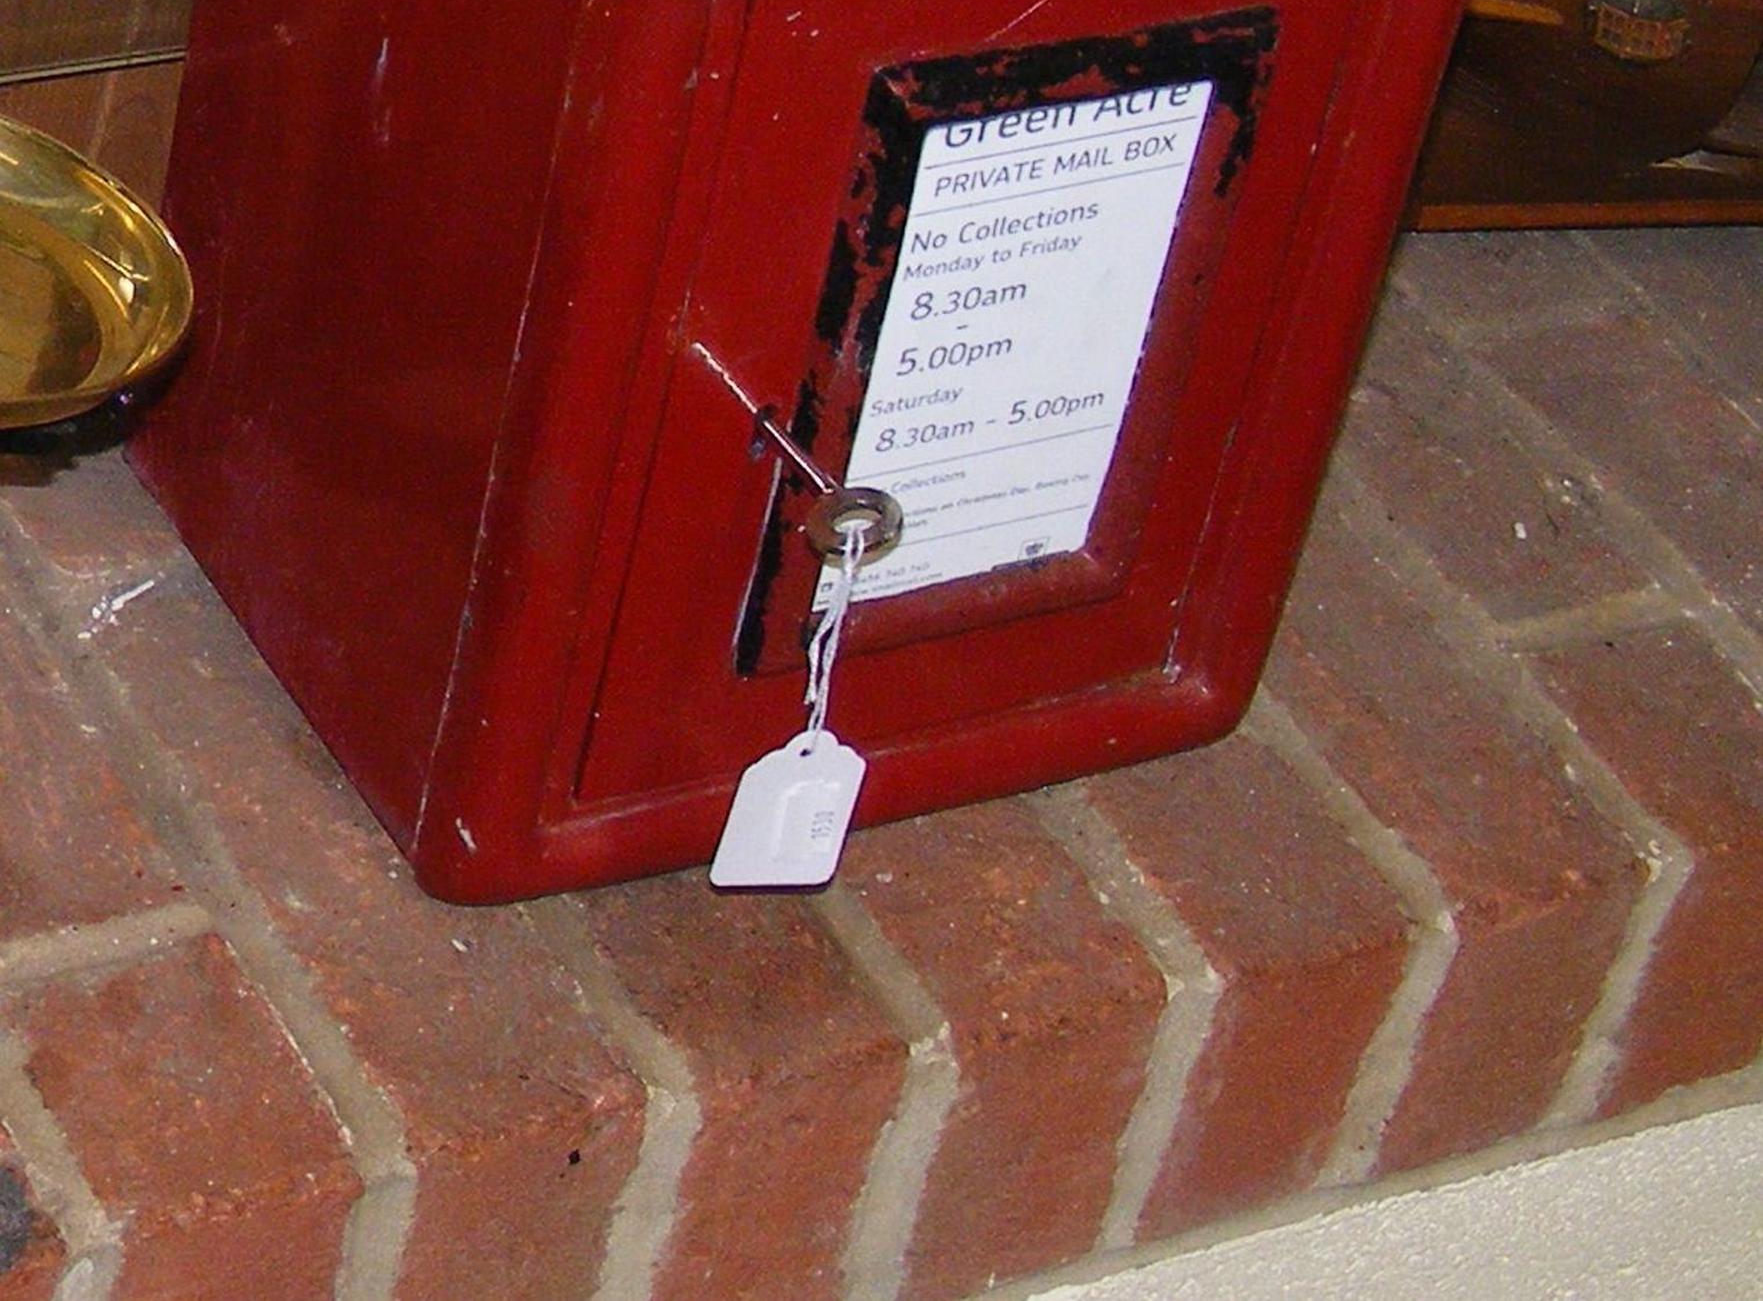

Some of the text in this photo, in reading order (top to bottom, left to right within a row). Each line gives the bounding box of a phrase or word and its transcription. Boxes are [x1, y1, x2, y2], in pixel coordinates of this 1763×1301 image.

[933, 132, 1179, 198] PRIVATE MAIL BOX
[909, 202, 1100, 255] No Collections
[902, 234, 1084, 282] Monday to Friday
[909, 282, 1028, 322] 8.30am
[895, 336, 1014, 377] 5.00pm
[868, 385, 965, 419] Saturday
[873, 419, 975, 454] 8.30am
[1007, 390, 1106, 426] 5.00pm
[890, 469, 968, 495] Collections
